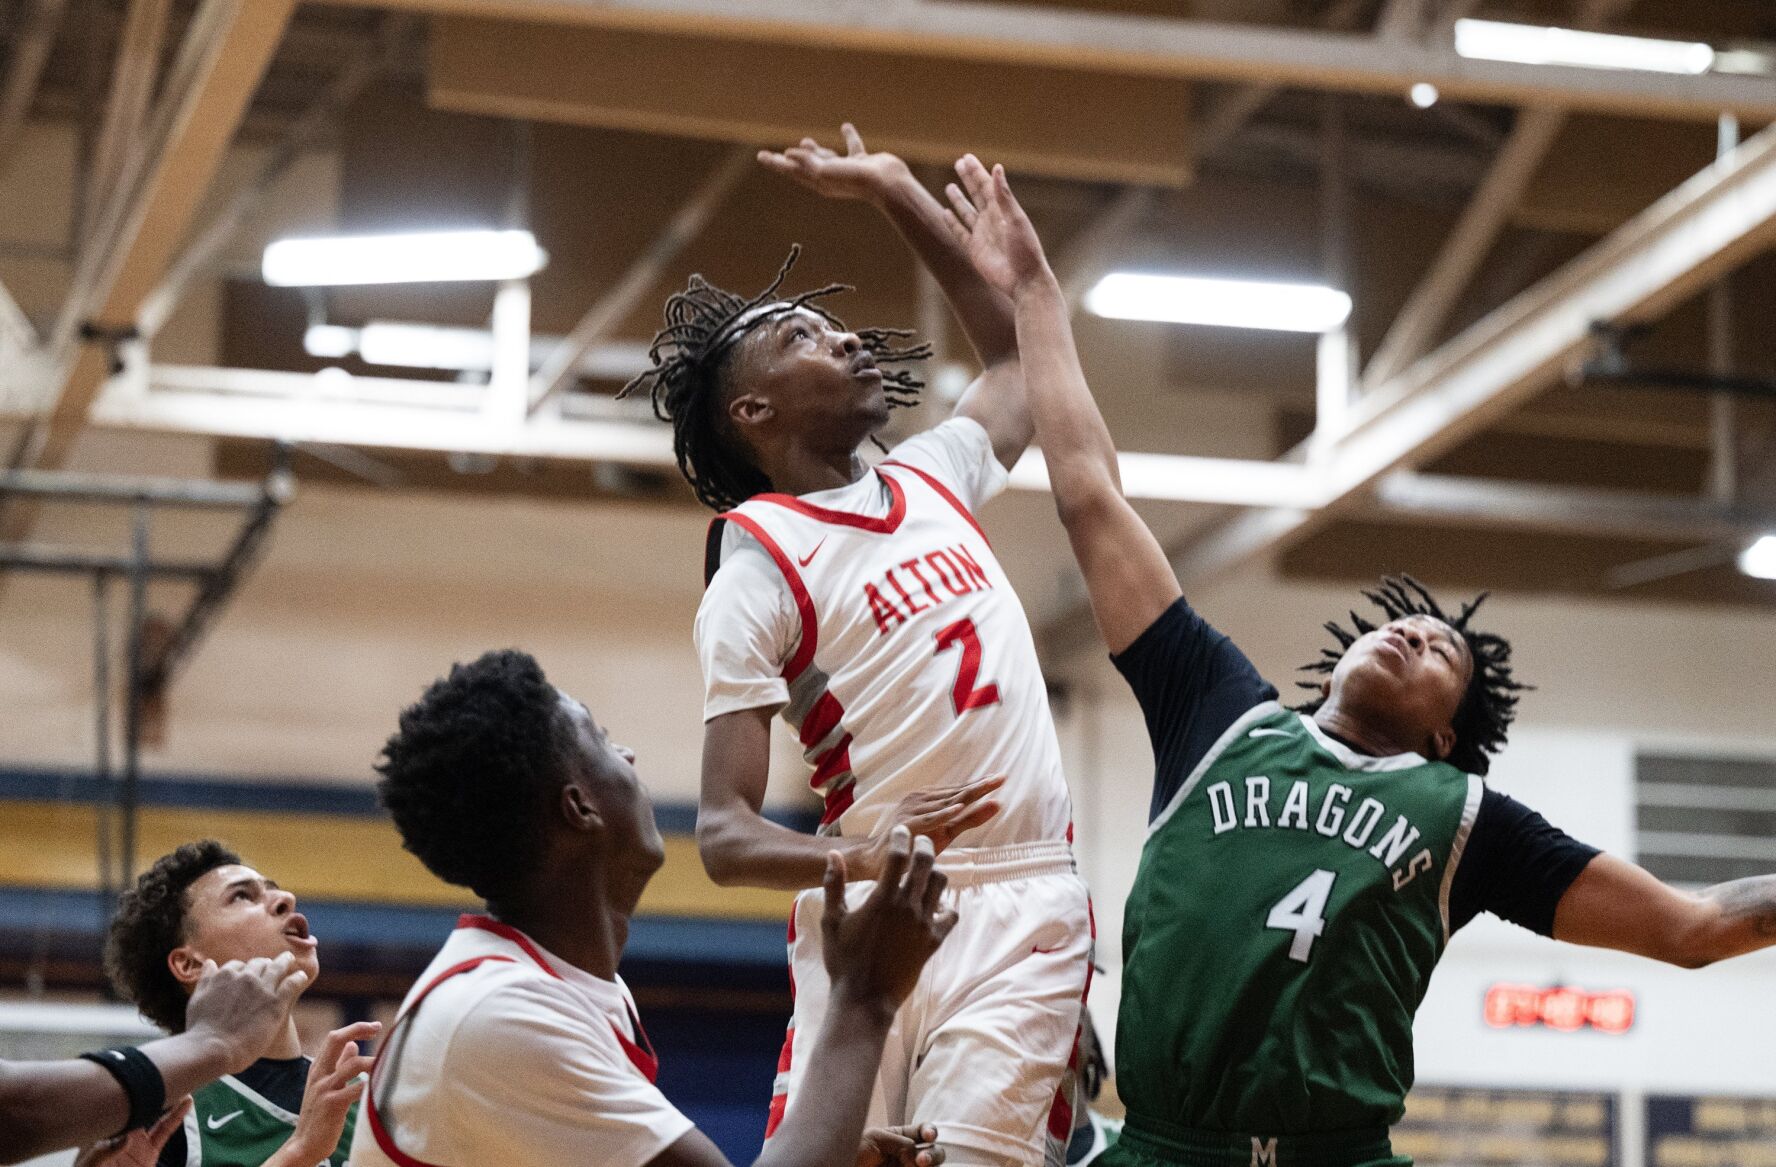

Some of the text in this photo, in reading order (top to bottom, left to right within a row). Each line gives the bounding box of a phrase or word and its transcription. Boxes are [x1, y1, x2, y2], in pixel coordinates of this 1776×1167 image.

[864, 543, 992, 636] ALTON
[932, 614, 1002, 720] 2
[1207, 775, 1432, 892] DRAGONS
[1266, 868, 1338, 963] 4
[1250, 1136, 1278, 1167] M
